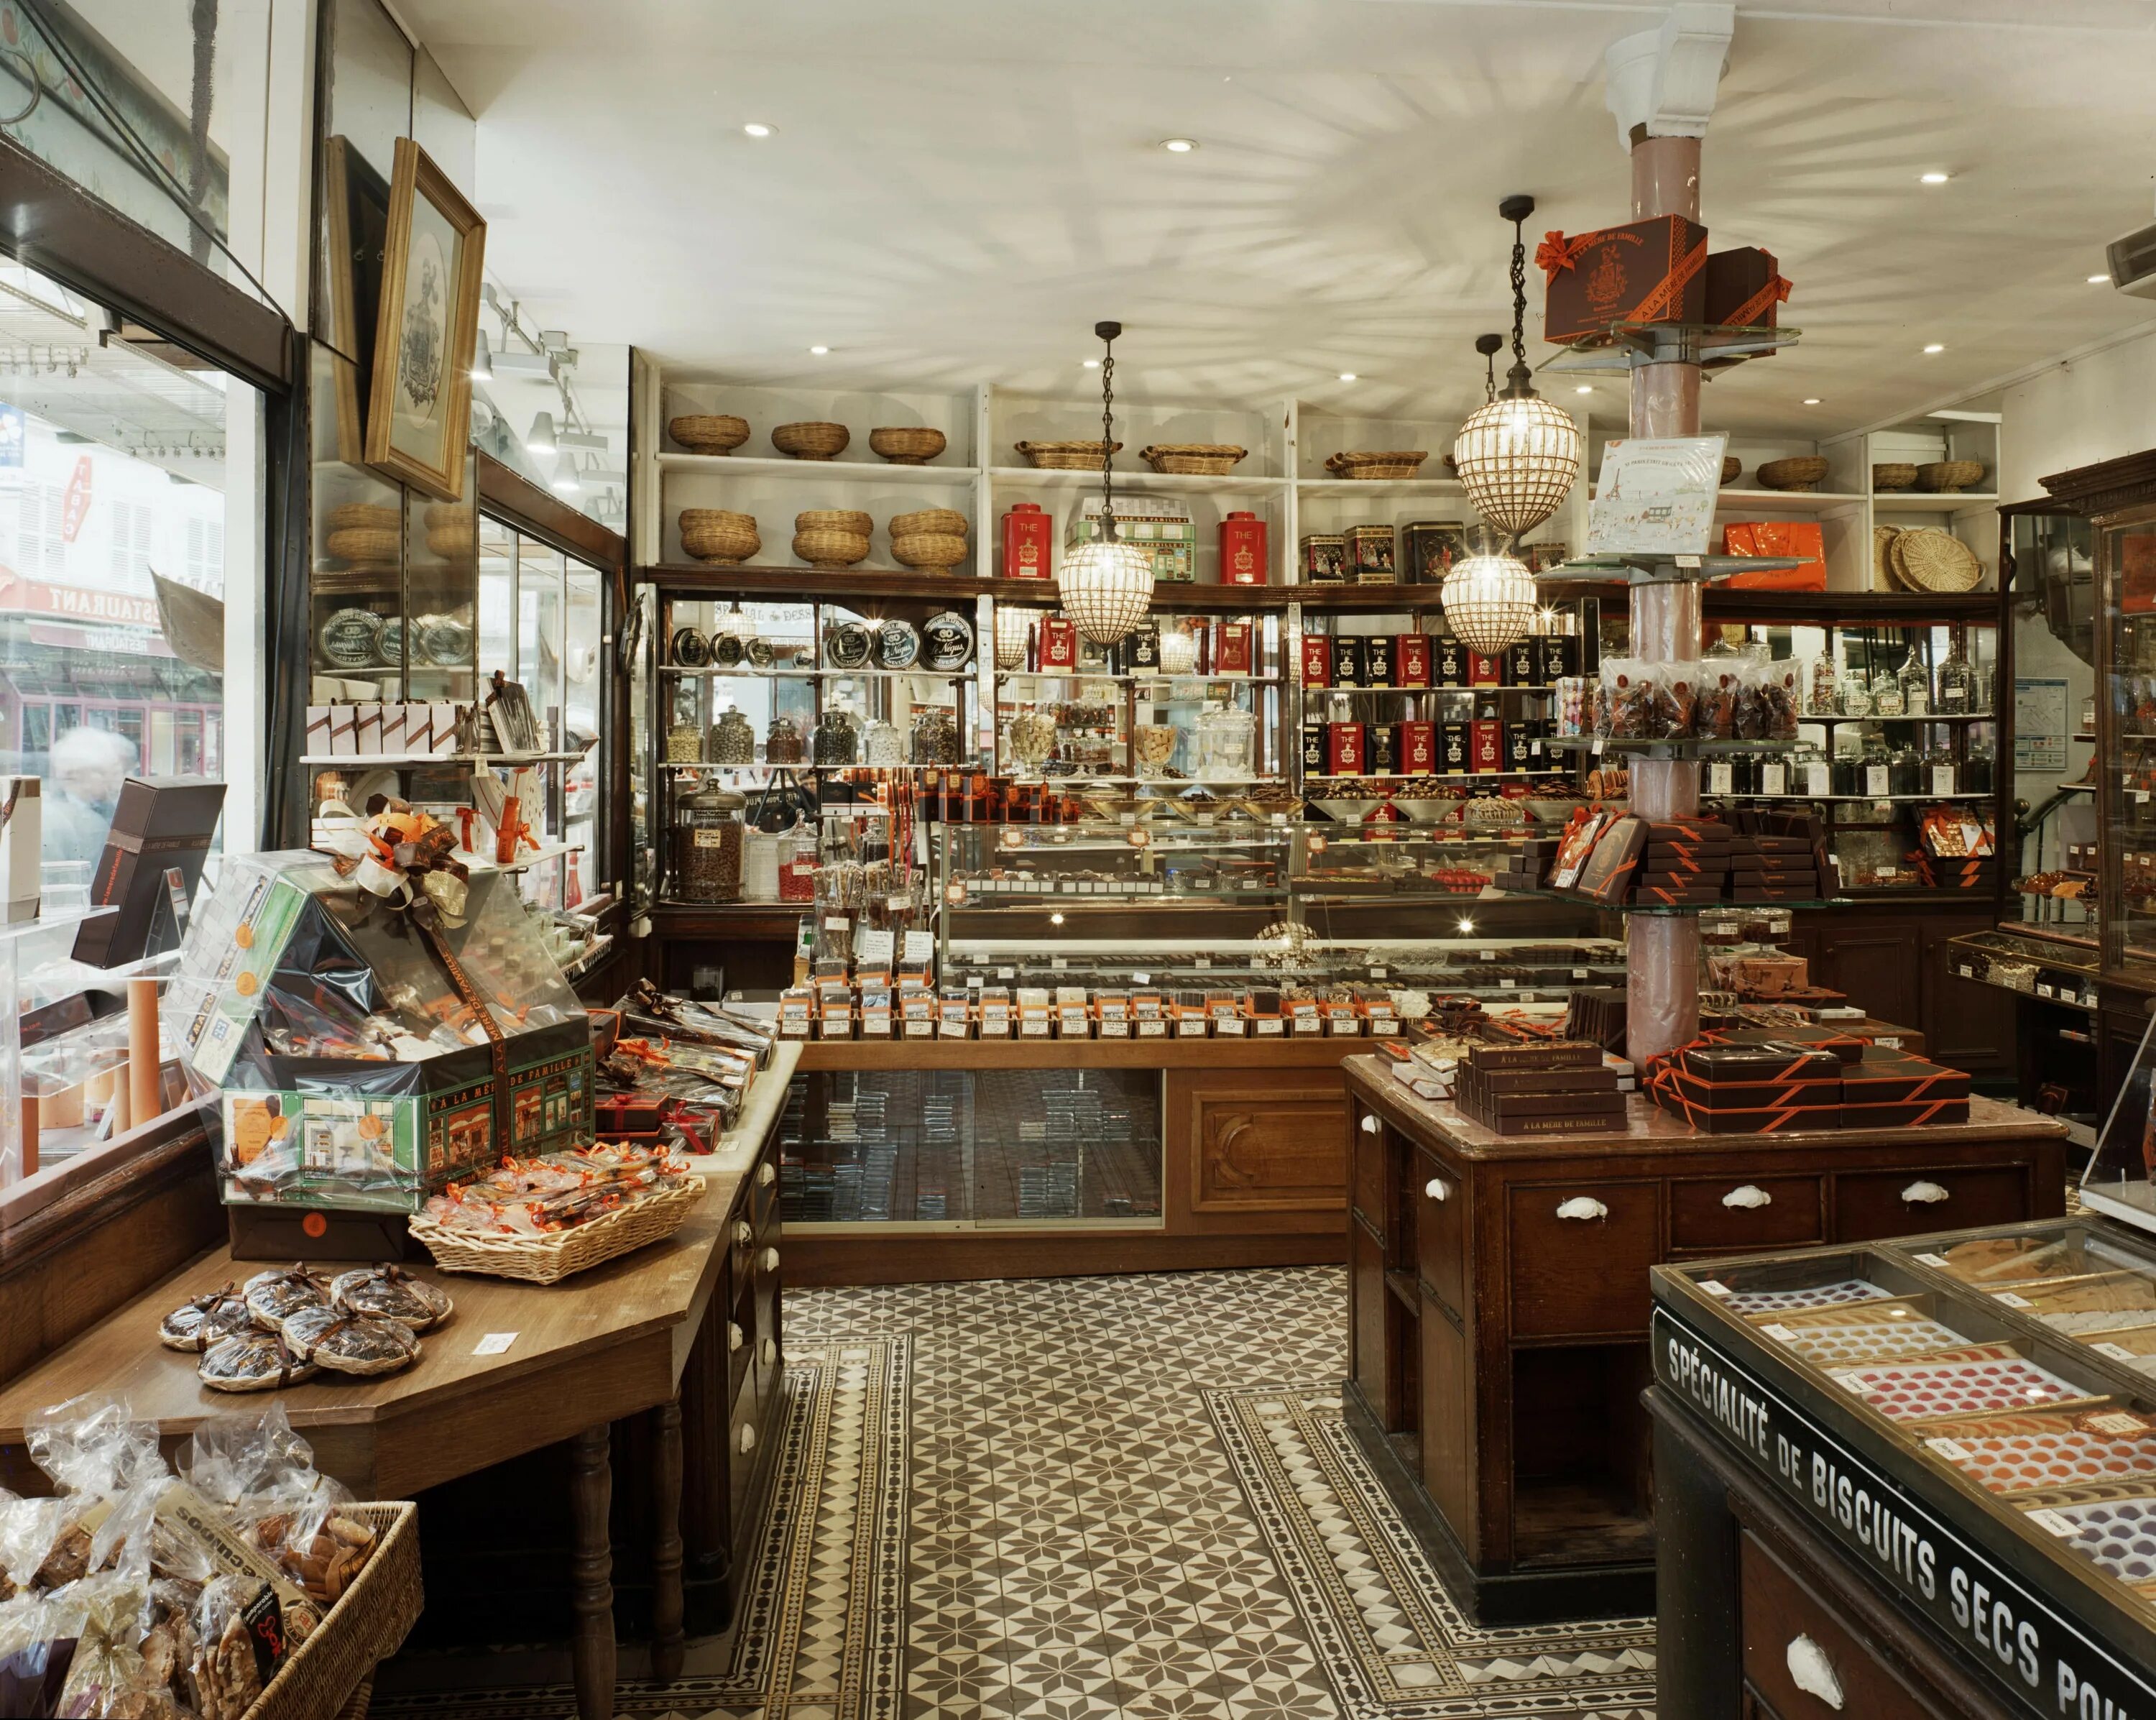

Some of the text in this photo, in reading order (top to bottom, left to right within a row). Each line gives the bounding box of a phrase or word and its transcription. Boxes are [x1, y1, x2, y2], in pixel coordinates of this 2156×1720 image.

[1618, 232, 1644, 247] FAMILLE
[1649, 299, 1659, 311] LA
[1685, 252, 1704, 275] FAMILLE
[443, 949, 471, 994] FAMILLE
[469, 995, 482, 1010] DE
[453, 1091, 468, 1105] LA
[474, 1082, 496, 1098] MÈ
[510, 1073, 524, 1086] DE
[528, 1059, 573, 1081] FAMILLE
[1576, 1118, 1607, 1128] FAMILLE
[1667, 1338, 1769, 1462] SPÉCIALITÉ
[1777, 1433, 1802, 1491] DE
[1811, 1450, 1937, 1602] BISCUITS
[1950, 1565, 2040, 1688] SECS
[175, 1506, 267, 1582] eculoos
